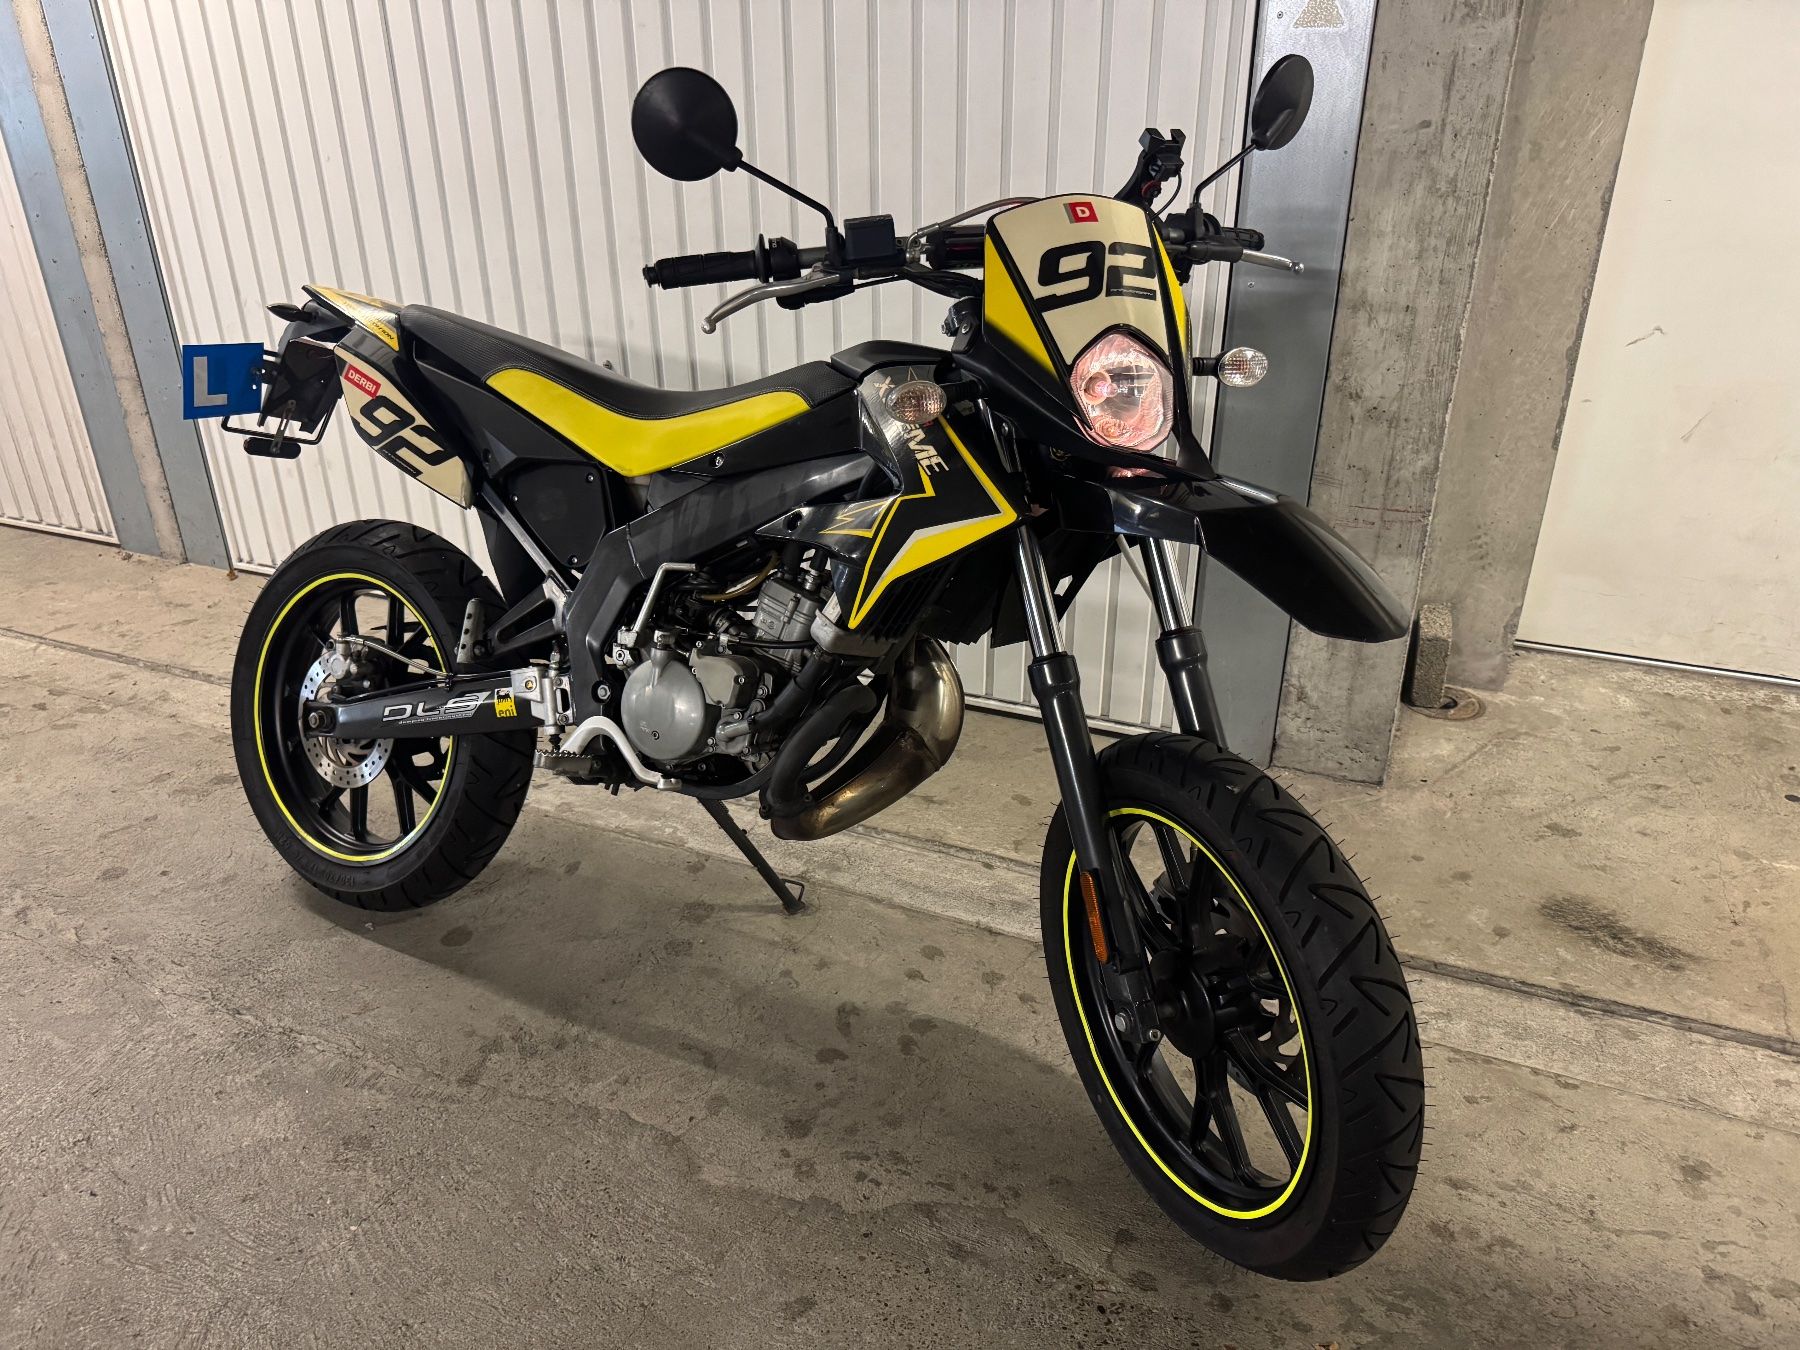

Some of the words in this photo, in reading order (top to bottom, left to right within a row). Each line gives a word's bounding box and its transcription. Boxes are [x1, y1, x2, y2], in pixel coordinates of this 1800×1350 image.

[1076, 205, 1090, 219] D
[1034, 240, 1157, 313] 92
[193, 356, 228, 408] L
[347, 369, 378, 394] DERBI
[353, 395, 453, 478] 92
[382, 691, 489, 722] DLS
[497, 704, 515, 718] eni
